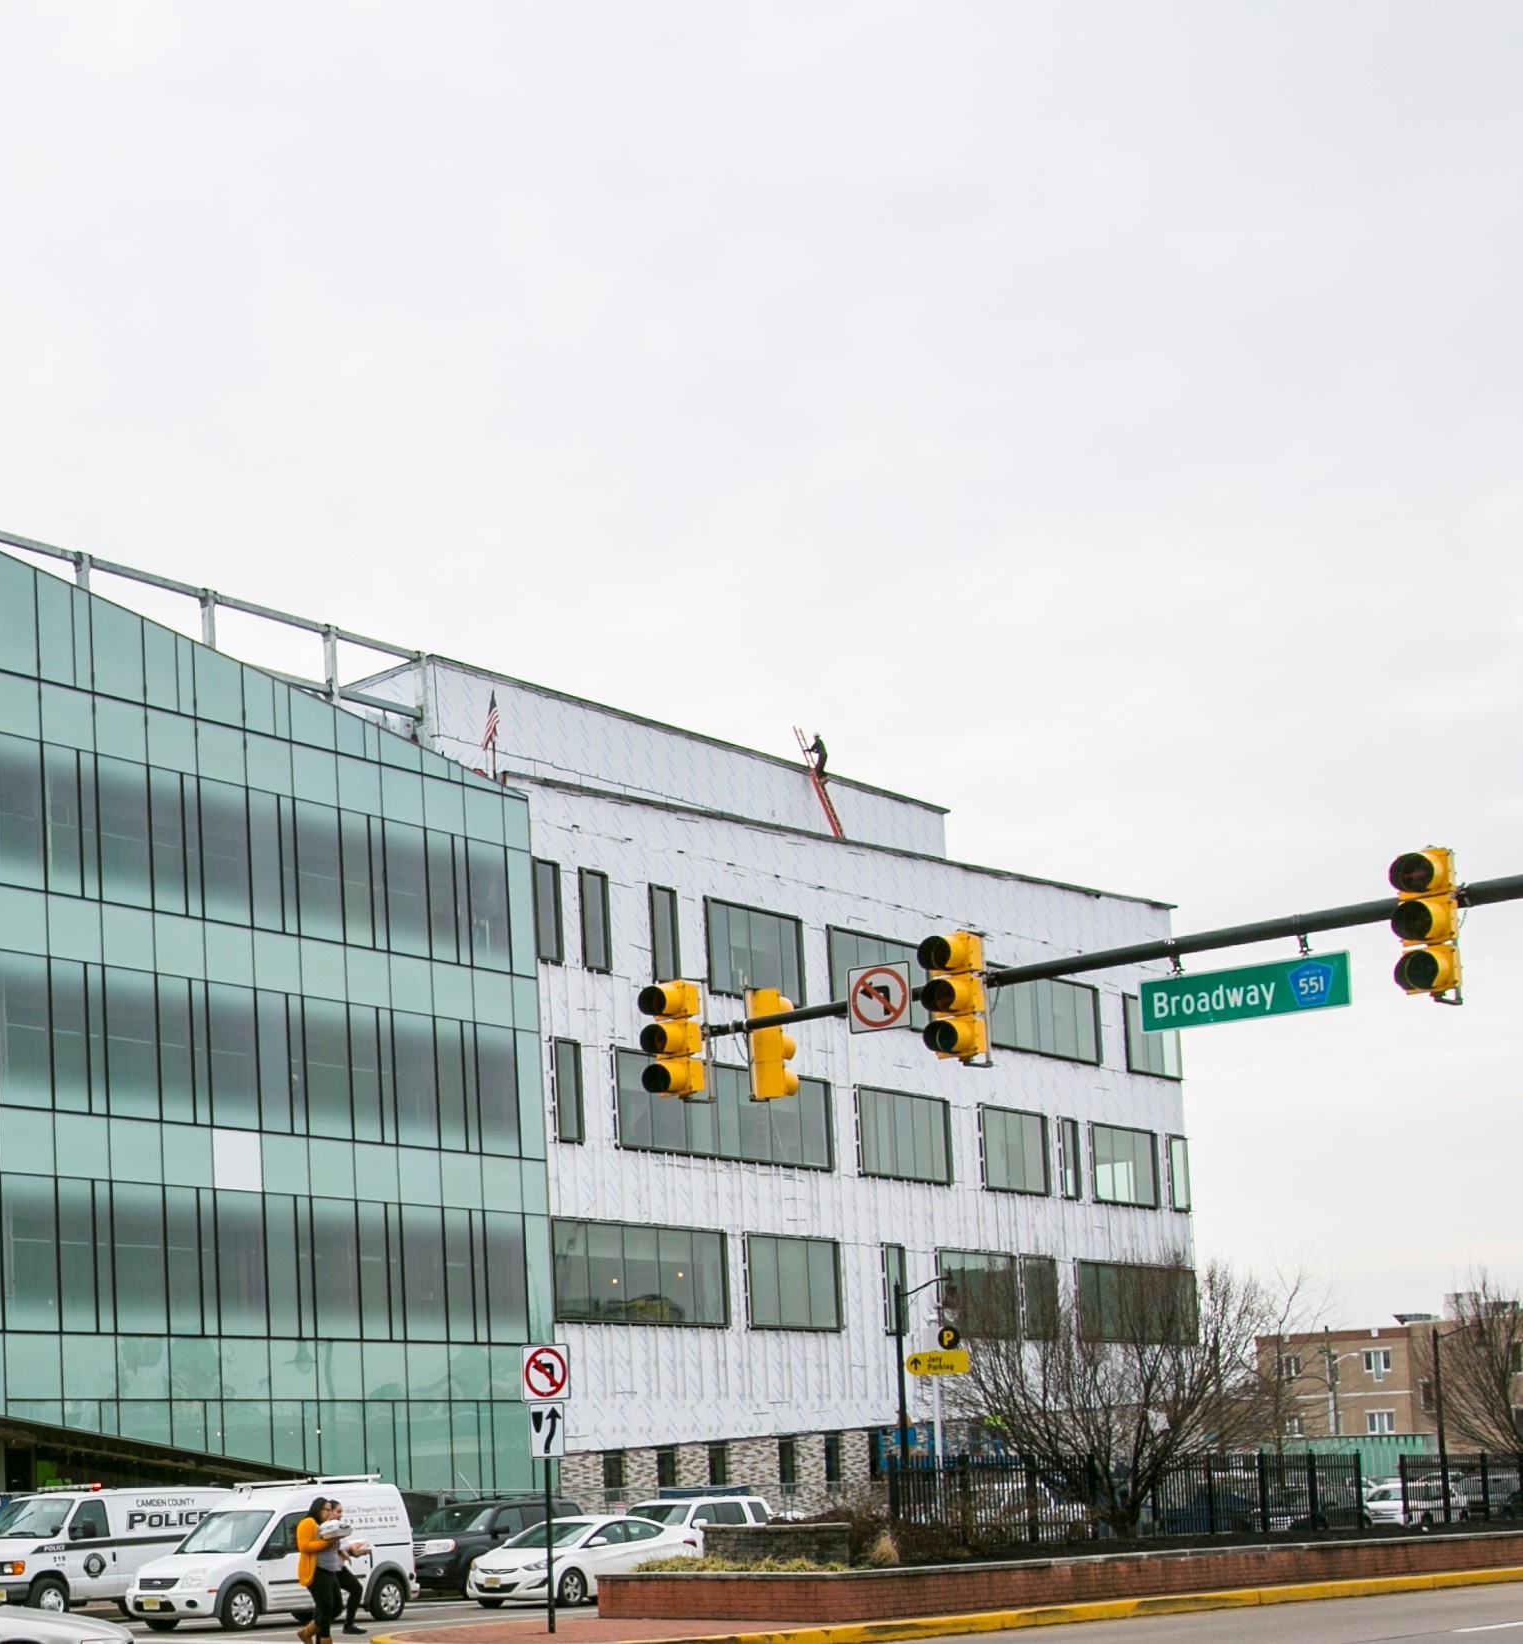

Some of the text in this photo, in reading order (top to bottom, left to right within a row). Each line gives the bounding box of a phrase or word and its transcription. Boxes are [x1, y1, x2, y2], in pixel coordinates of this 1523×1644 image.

[1298, 975, 1325, 996] 551
[1153, 982, 1276, 1019] Broadway
[943, 1331, 954, 1346] P
[136, 1498, 195, 1507] CAMDEN COUNTY
